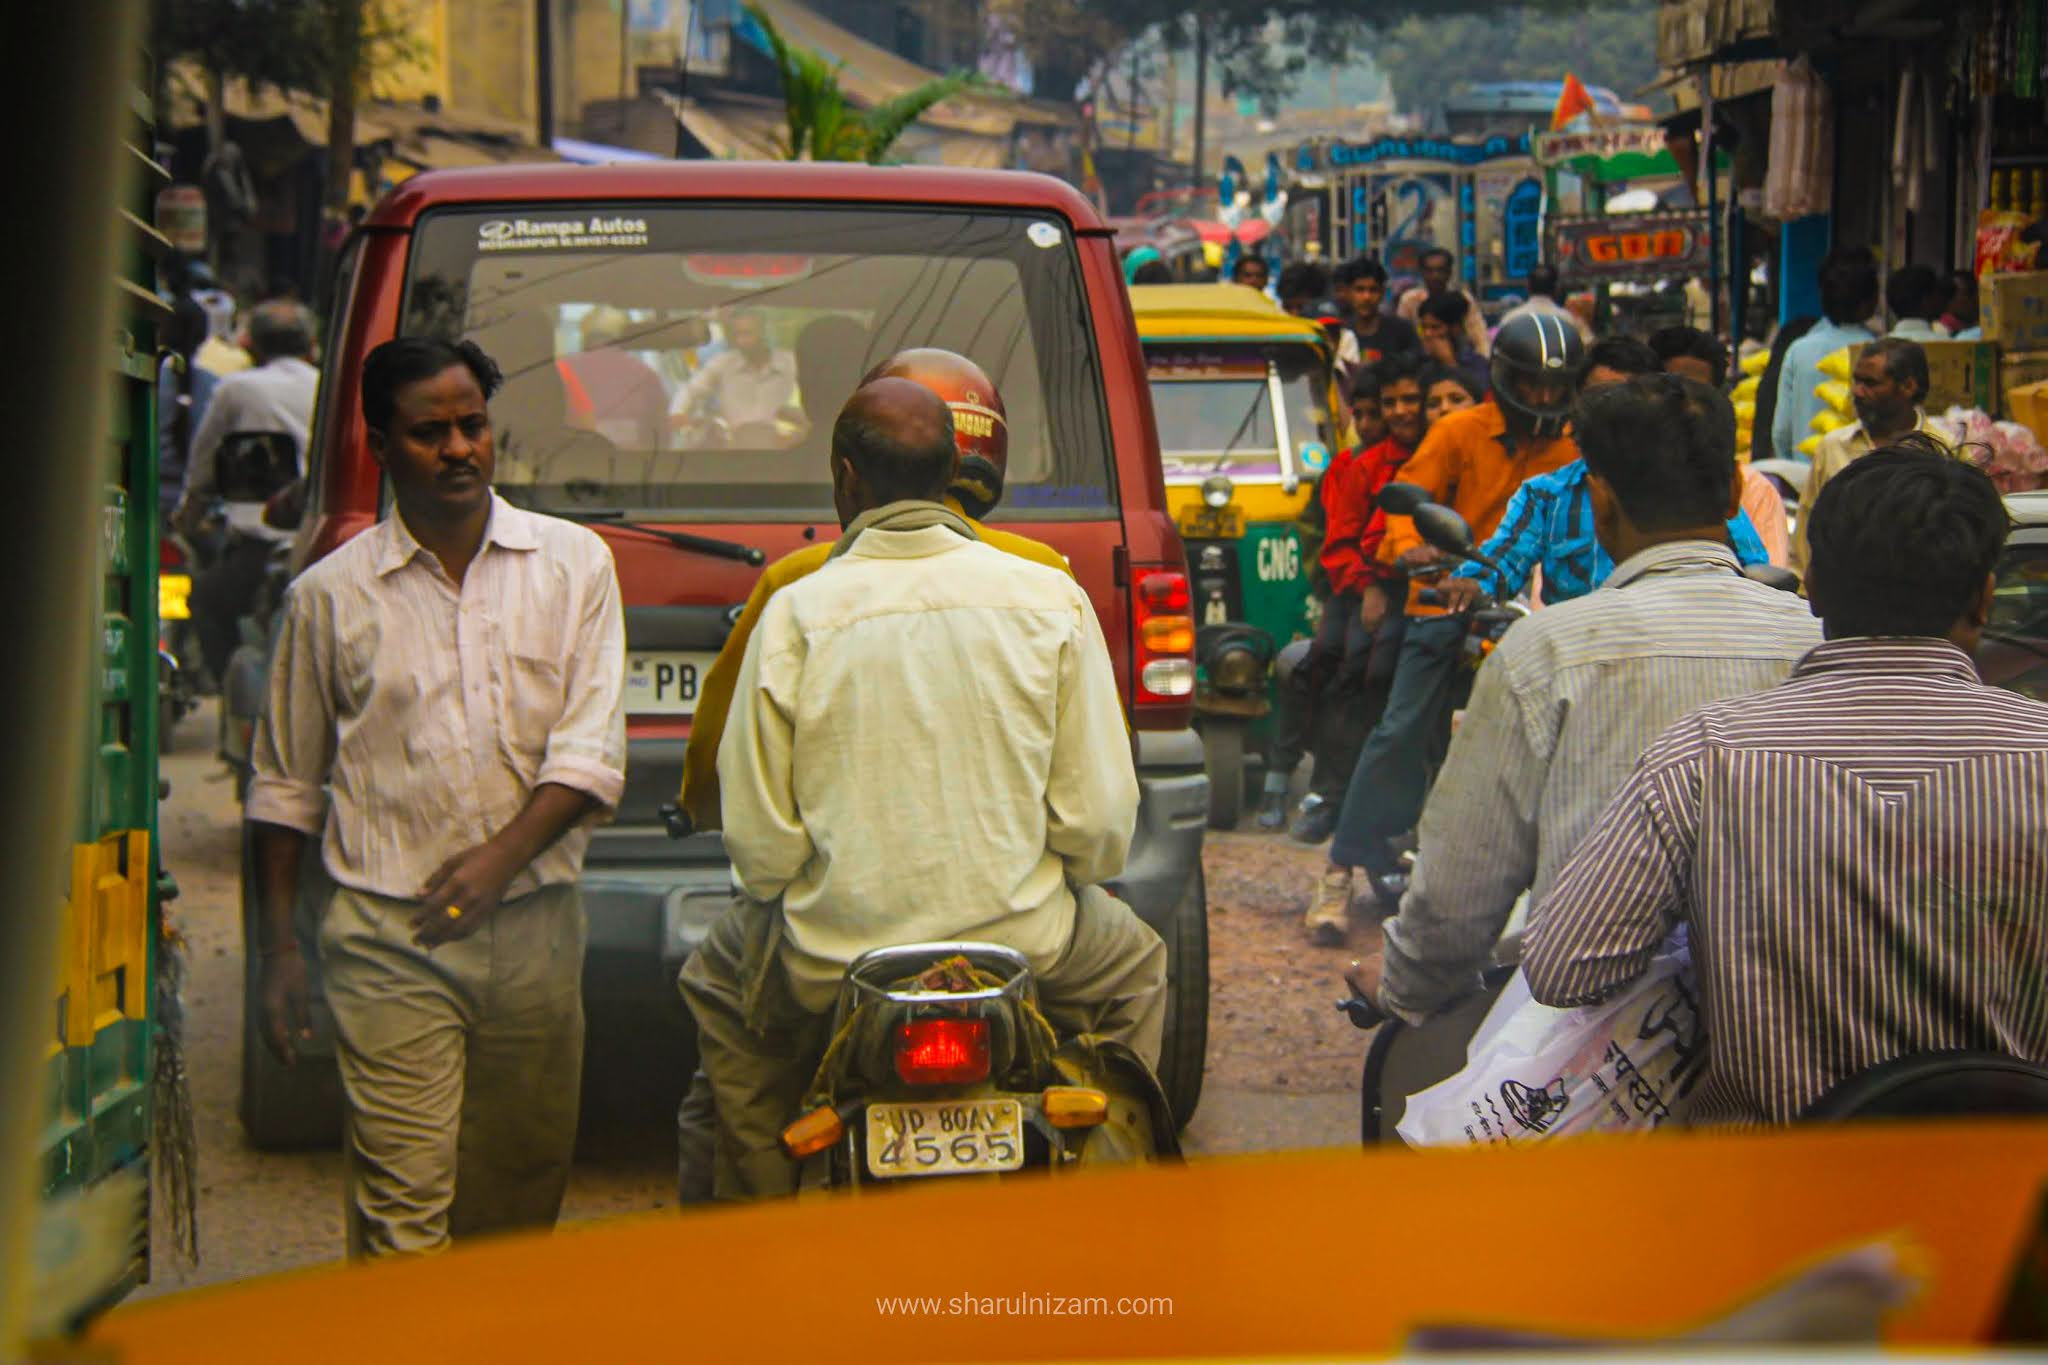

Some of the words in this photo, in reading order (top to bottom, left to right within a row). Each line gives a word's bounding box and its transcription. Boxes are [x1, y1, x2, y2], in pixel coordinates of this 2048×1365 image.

[514, 219, 585, 237] Rampa
[589, 216, 647, 234] Autos
[1257, 536, 1299, 581] CNG
[656, 663, 697, 701] PB
[879, 1133, 1016, 1166] 4565
